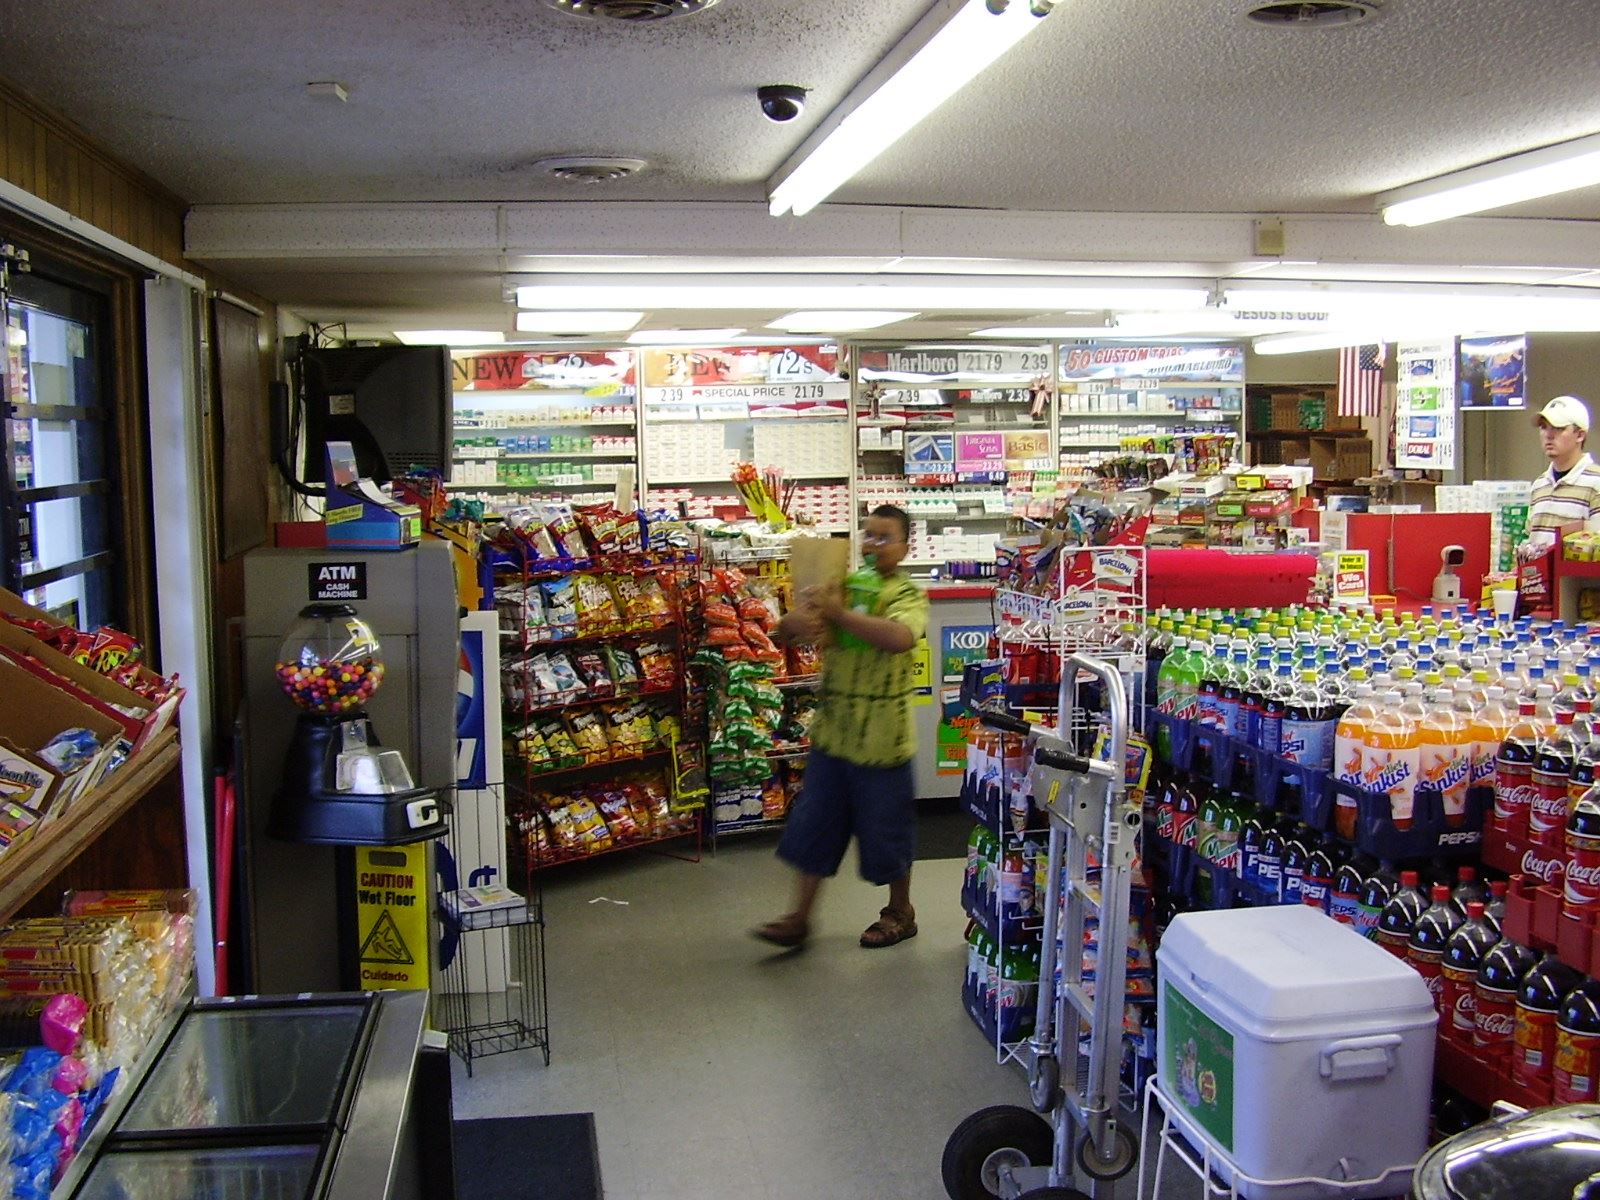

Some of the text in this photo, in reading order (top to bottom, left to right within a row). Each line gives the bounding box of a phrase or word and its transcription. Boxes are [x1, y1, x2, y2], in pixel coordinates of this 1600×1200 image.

[1233, 310, 1277, 320] JESUS
[1280, 311, 1294, 320] IS
[887, 352, 956, 373] Marlboro
[1065, 350, 1091, 372] 50
[1094, 347, 1149, 364] CUSTOM
[452, 356, 519, 381] NEW
[705, 387, 751, 398] SPECIAL
[753, 386, 786, 398] PRICE
[318, 566, 357, 580] ATM
[1342, 573, 1360, 582] We
[325, 583, 350, 591] CASH
[1338, 579, 1365, 591] Card
[318, 590, 358, 599] MACHINE
[0, 764, 43, 788] oonPie
[360, 872, 414, 889] CAUTION
[358, 890, 417, 906] Wet Floor
[361, 969, 409, 982] Cuidado
